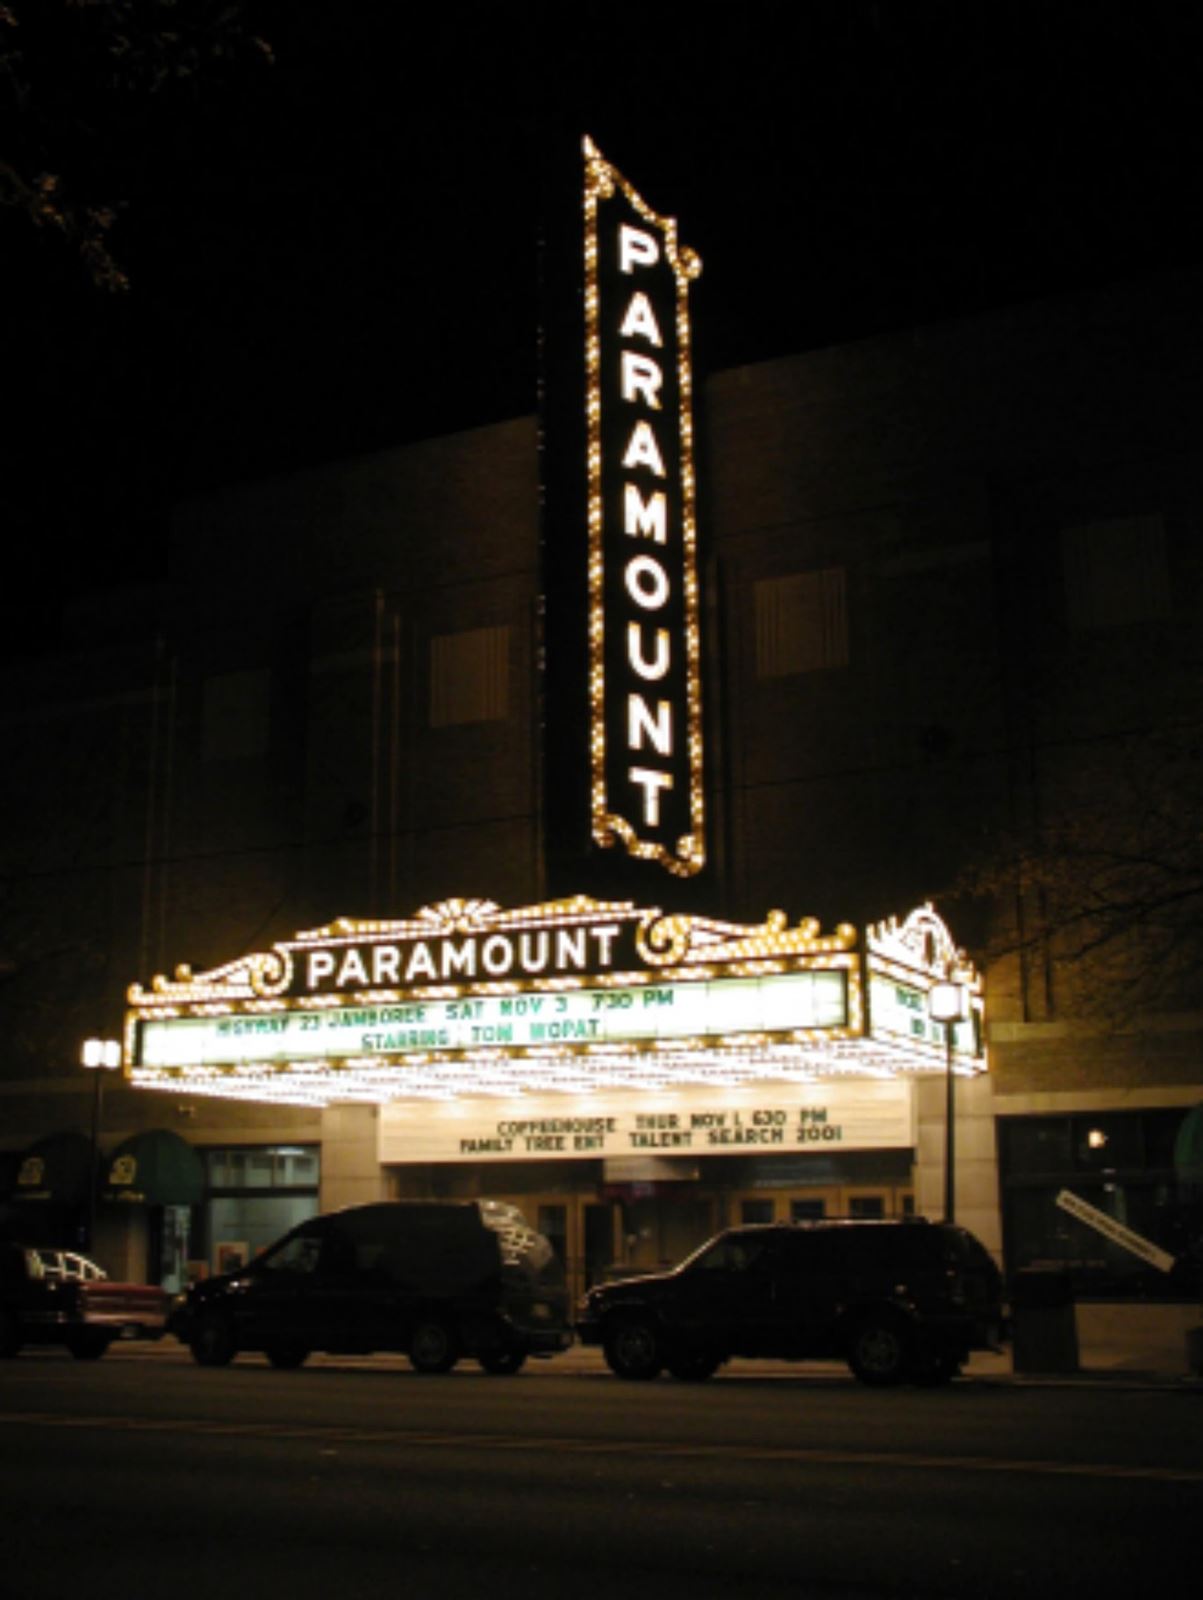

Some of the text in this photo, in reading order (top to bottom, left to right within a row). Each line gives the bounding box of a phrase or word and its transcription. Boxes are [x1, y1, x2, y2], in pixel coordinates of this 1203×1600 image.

[619, 223, 674, 826] PARAMOUNT
[307, 925, 619, 988] PARAMOUNT
[446, 1001, 484, 1020] SAT
[500, 997, 542, 1016] NOV
[555, 997, 568, 1012] 3
[643, 989, 674, 1006] PM
[361, 1018, 600, 1050] STARRING TOM WOPAT
[497, 1117, 615, 1136] COFFEEHOUSE
[691, 1113, 725, 1126] NOV
[800, 1106, 827, 1122] PM
[460, 1138, 513, 1154] FAMILY
[525, 1135, 565, 1150] TREE
[629, 1131, 692, 1147] TALENT
[708, 1127, 784, 1145] SEARCH
[797, 1125, 842, 1142] 2001
